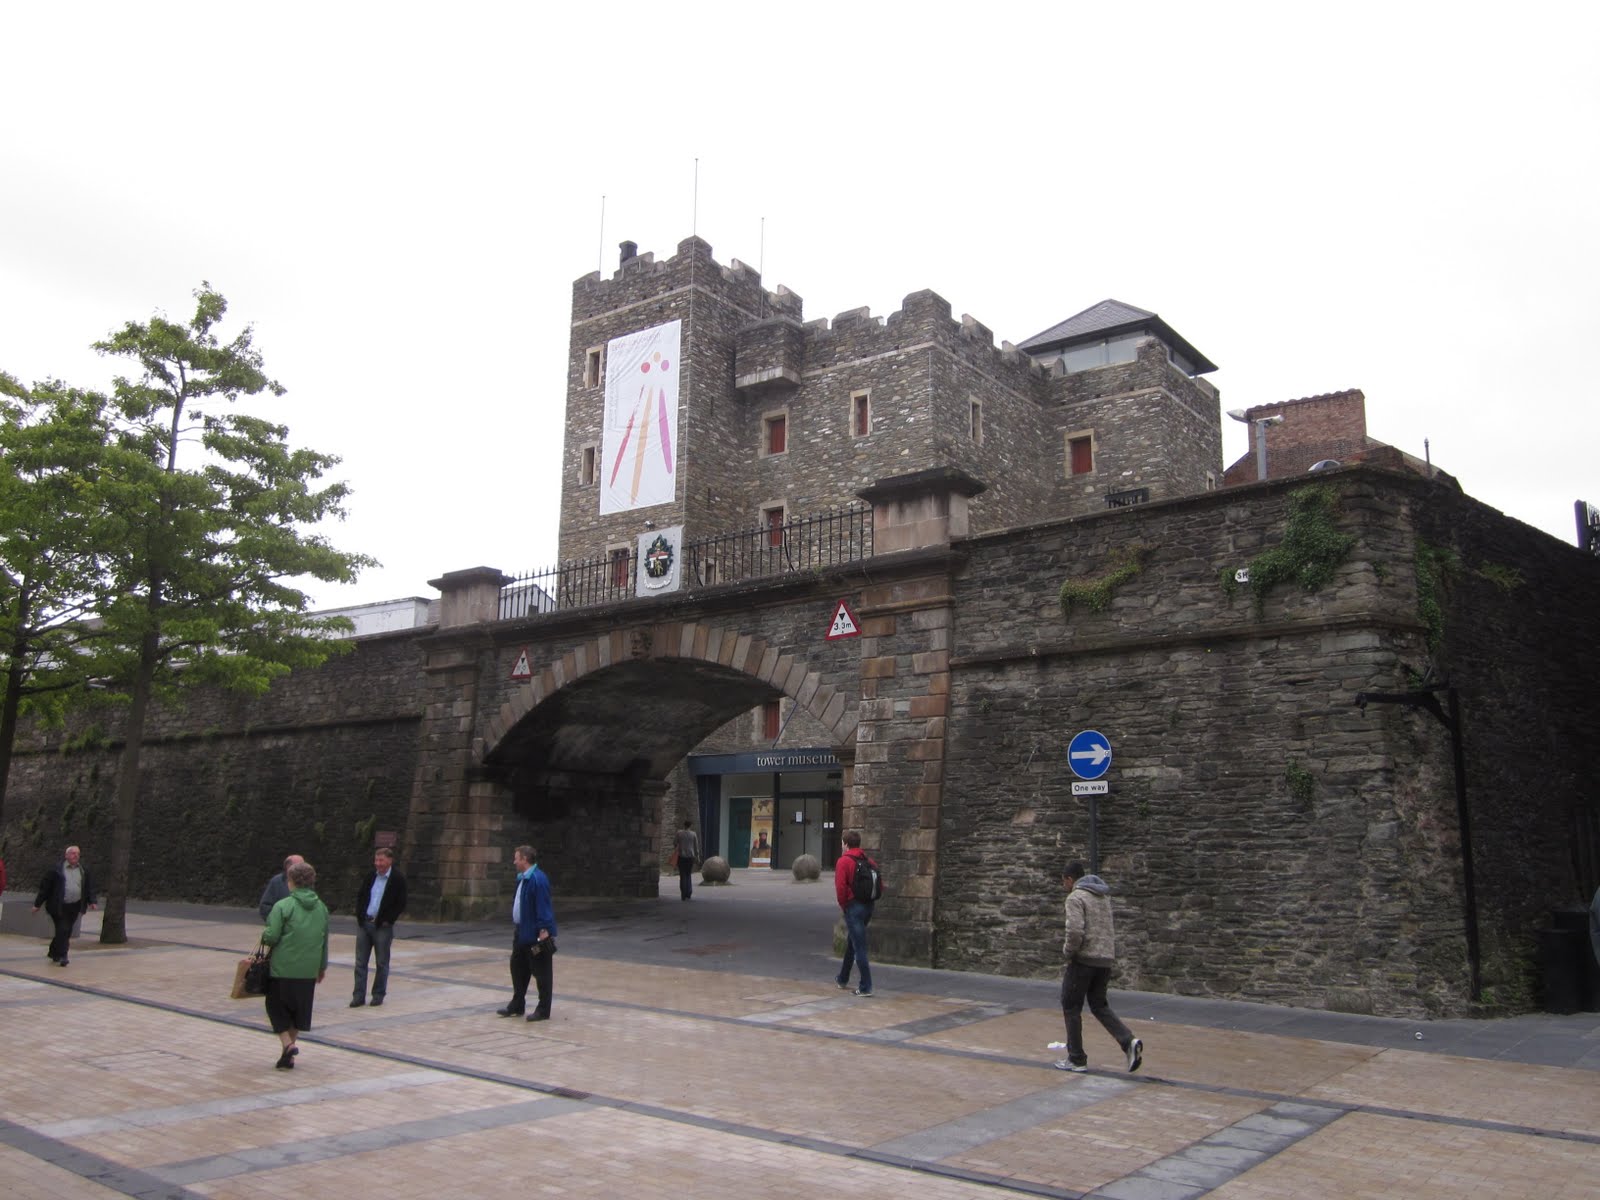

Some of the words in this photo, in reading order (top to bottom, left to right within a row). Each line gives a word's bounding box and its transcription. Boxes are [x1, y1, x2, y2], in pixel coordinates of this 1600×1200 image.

[833, 622, 852, 631] 3.3m
[757, 756, 786, 767] tower
[1074, 784, 1089, 792] One
